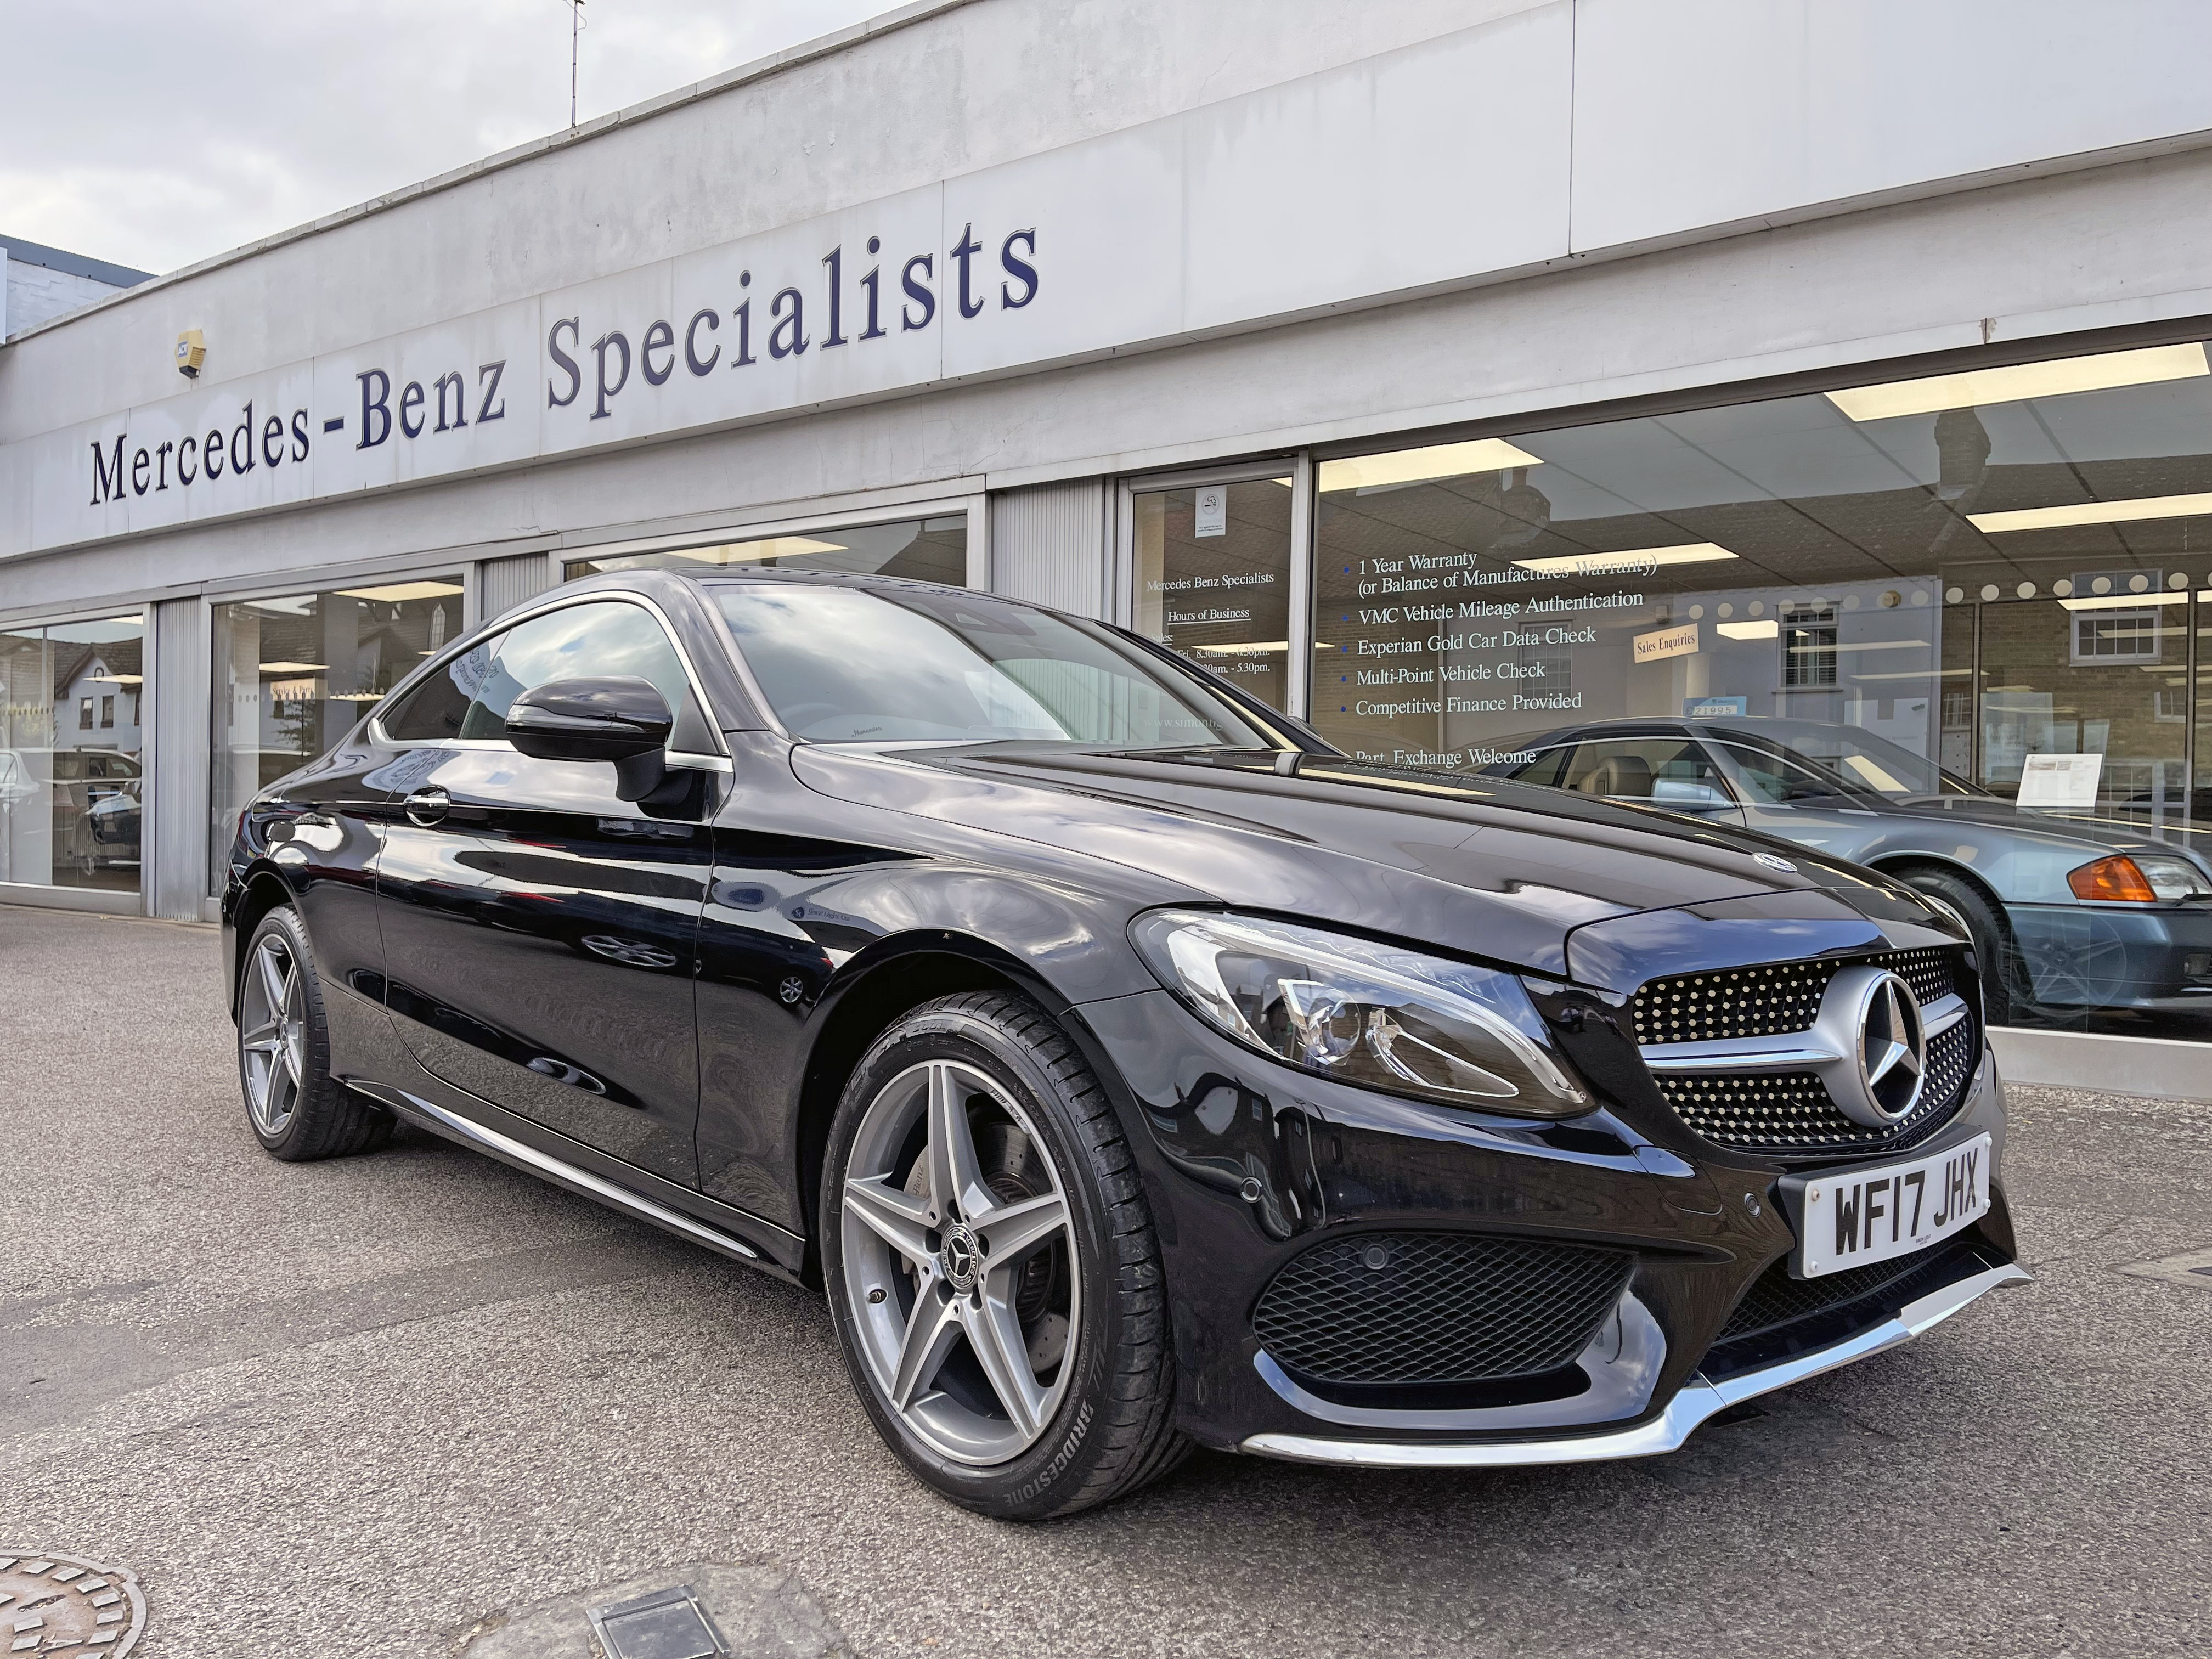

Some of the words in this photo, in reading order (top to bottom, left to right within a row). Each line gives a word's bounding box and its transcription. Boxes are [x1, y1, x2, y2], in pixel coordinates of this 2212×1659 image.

[89, 359, 506, 506] Mercedes-Benz
[548, 222, 1039, 422] Specialists
[1359, 560, 1365, 575] 1
[1372, 558, 1404, 574] Year
[1408, 552, 1477, 571] Warranty
[1147, 579, 1191, 591] Mercedes
[1194, 577, 1219, 588] Benz
[1222, 572, 1274, 589] Specialists
[1358, 579, 1377, 599] (or
[1381, 576, 1438, 593] Balance
[1443, 572, 1459, 588] of
[1463, 567, 1569, 586] Manufactures
[1575, 554, 1657, 577] Warranty)
[1168, 611, 1195, 622] Hours
[1198, 610, 1208, 620] of
[1210, 608, 1250, 619] Business
[1358, 607, 1398, 625] VMC
[1403, 603, 1453, 622] Vehicle
[1459, 601, 1520, 619] Mileage
[1525, 590, 1643, 613] Authentication
[1196, 650, 1228, 659] 8.30am.
[1237, 647, 1271, 659] 6.30pm.
[1357, 637, 1422, 658] Experian
[1427, 634, 1463, 651] Gold
[1469, 633, 1497, 648] Car
[1502, 631, 1540, 647] Data
[1545, 626, 1596, 645] Check
[1638, 641, 1656, 654] Sales
[1658, 633, 1695, 651] Enquiries
[1237, 662, 1271, 674] 5.30pm.
[1357, 667, 1434, 685] Multi-Point
[1438, 664, 1491, 681] Vehicle
[1497, 662, 1546, 679] Check
[1356, 698, 1441, 719] Competitive
[1446, 696, 1506, 712] Finance
[1512, 692, 1582, 710] Provided
[1356, 751, 1385, 762] Part
[1393, 749, 1462, 769] Exchange
[1468, 748, 1537, 764] Welcome
[1836, 1170, 1925, 1255] WF17
[1934, 1148, 1978, 1228] JHX
[1002, 1399, 1094, 1507] BRIDGESTONE
